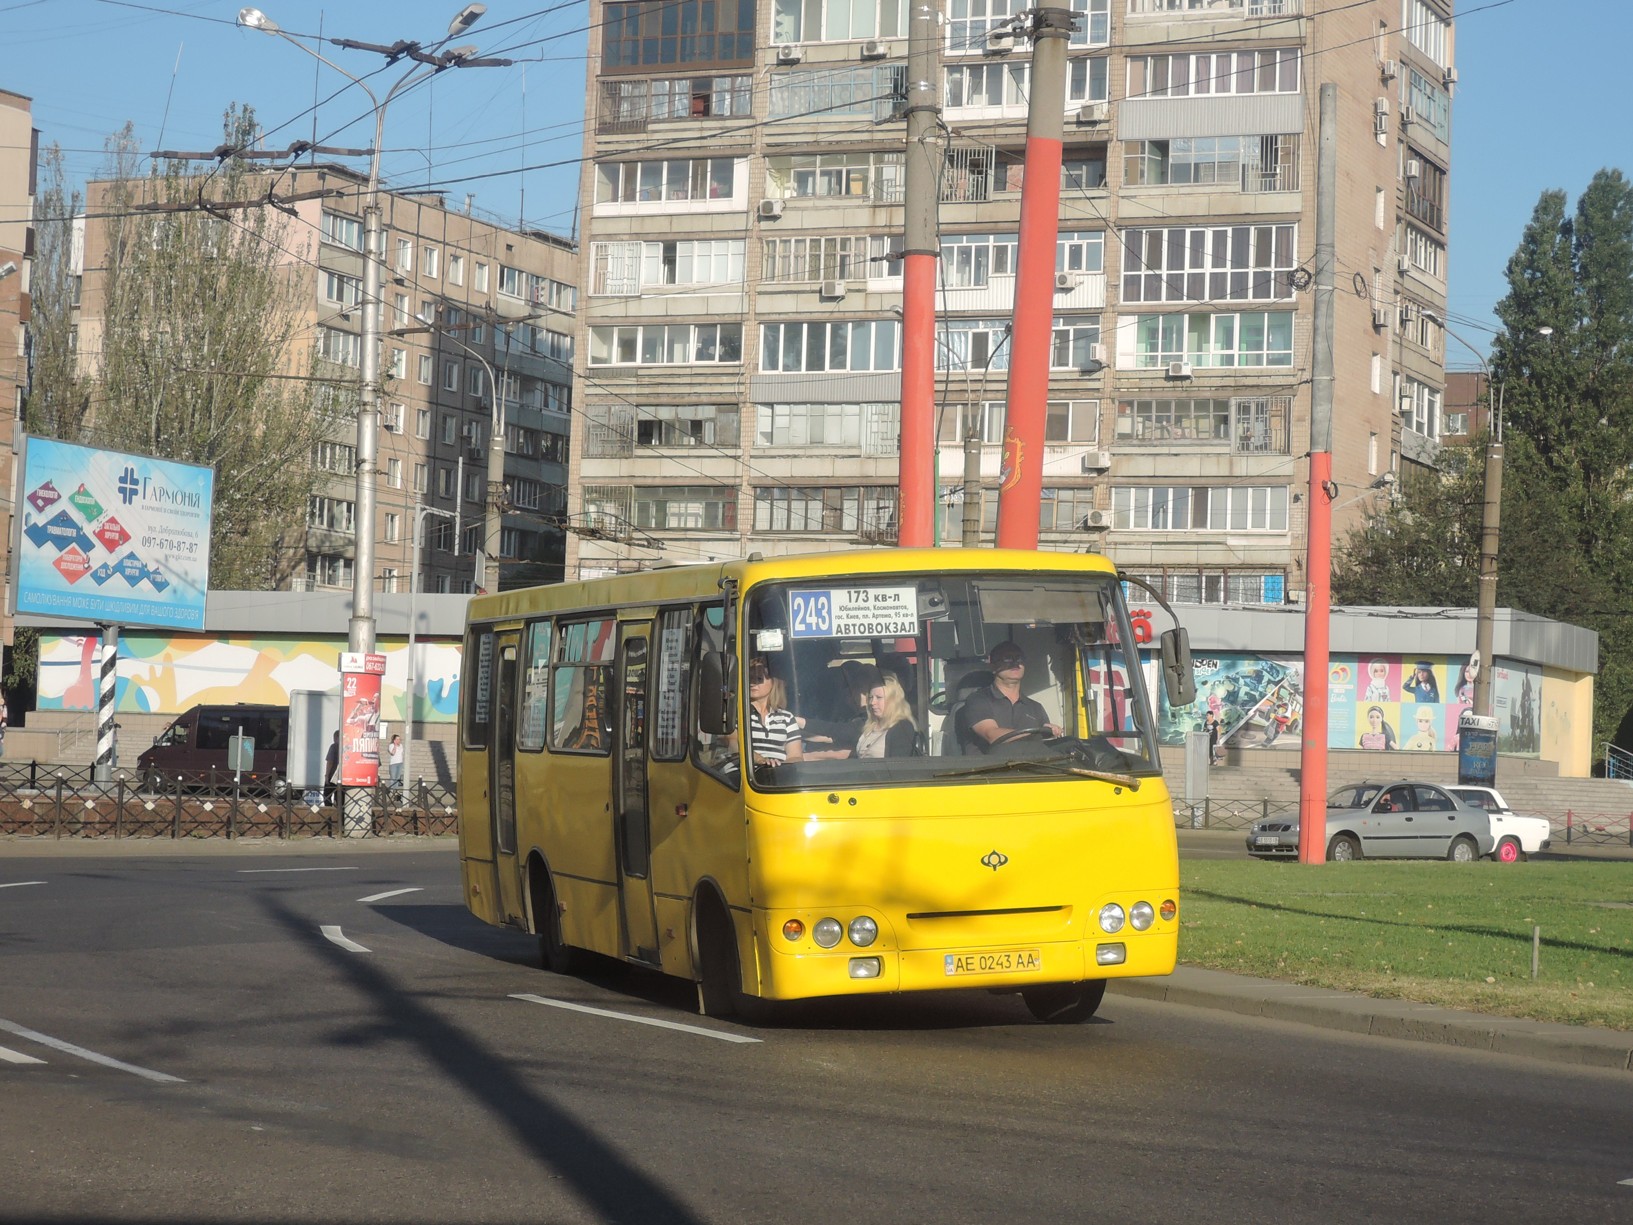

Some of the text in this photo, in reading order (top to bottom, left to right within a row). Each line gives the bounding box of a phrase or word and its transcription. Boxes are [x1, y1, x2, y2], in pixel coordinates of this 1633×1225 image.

[141, 536, 198, 553] 097-670-87-87
[847, 590, 900, 603] 173 кв-л
[24, 591, 72, 606] САМОЛІКУВАННЯ
[73, 597, 90, 609] МОЖЕ
[90, 599, 104, 610] БУТИ
[138, 604, 151, 616] ДЛЯ
[151, 605, 174, 618] ВАШОГО
[793, 596, 830, 631] 243
[835, 622, 915, 635] АВТОВОКЗАЛ
[347, 677, 357, 688] 22
[1460, 717, 1480, 726] TAXI
[955, 953, 1036, 972] AE 0243 AA
